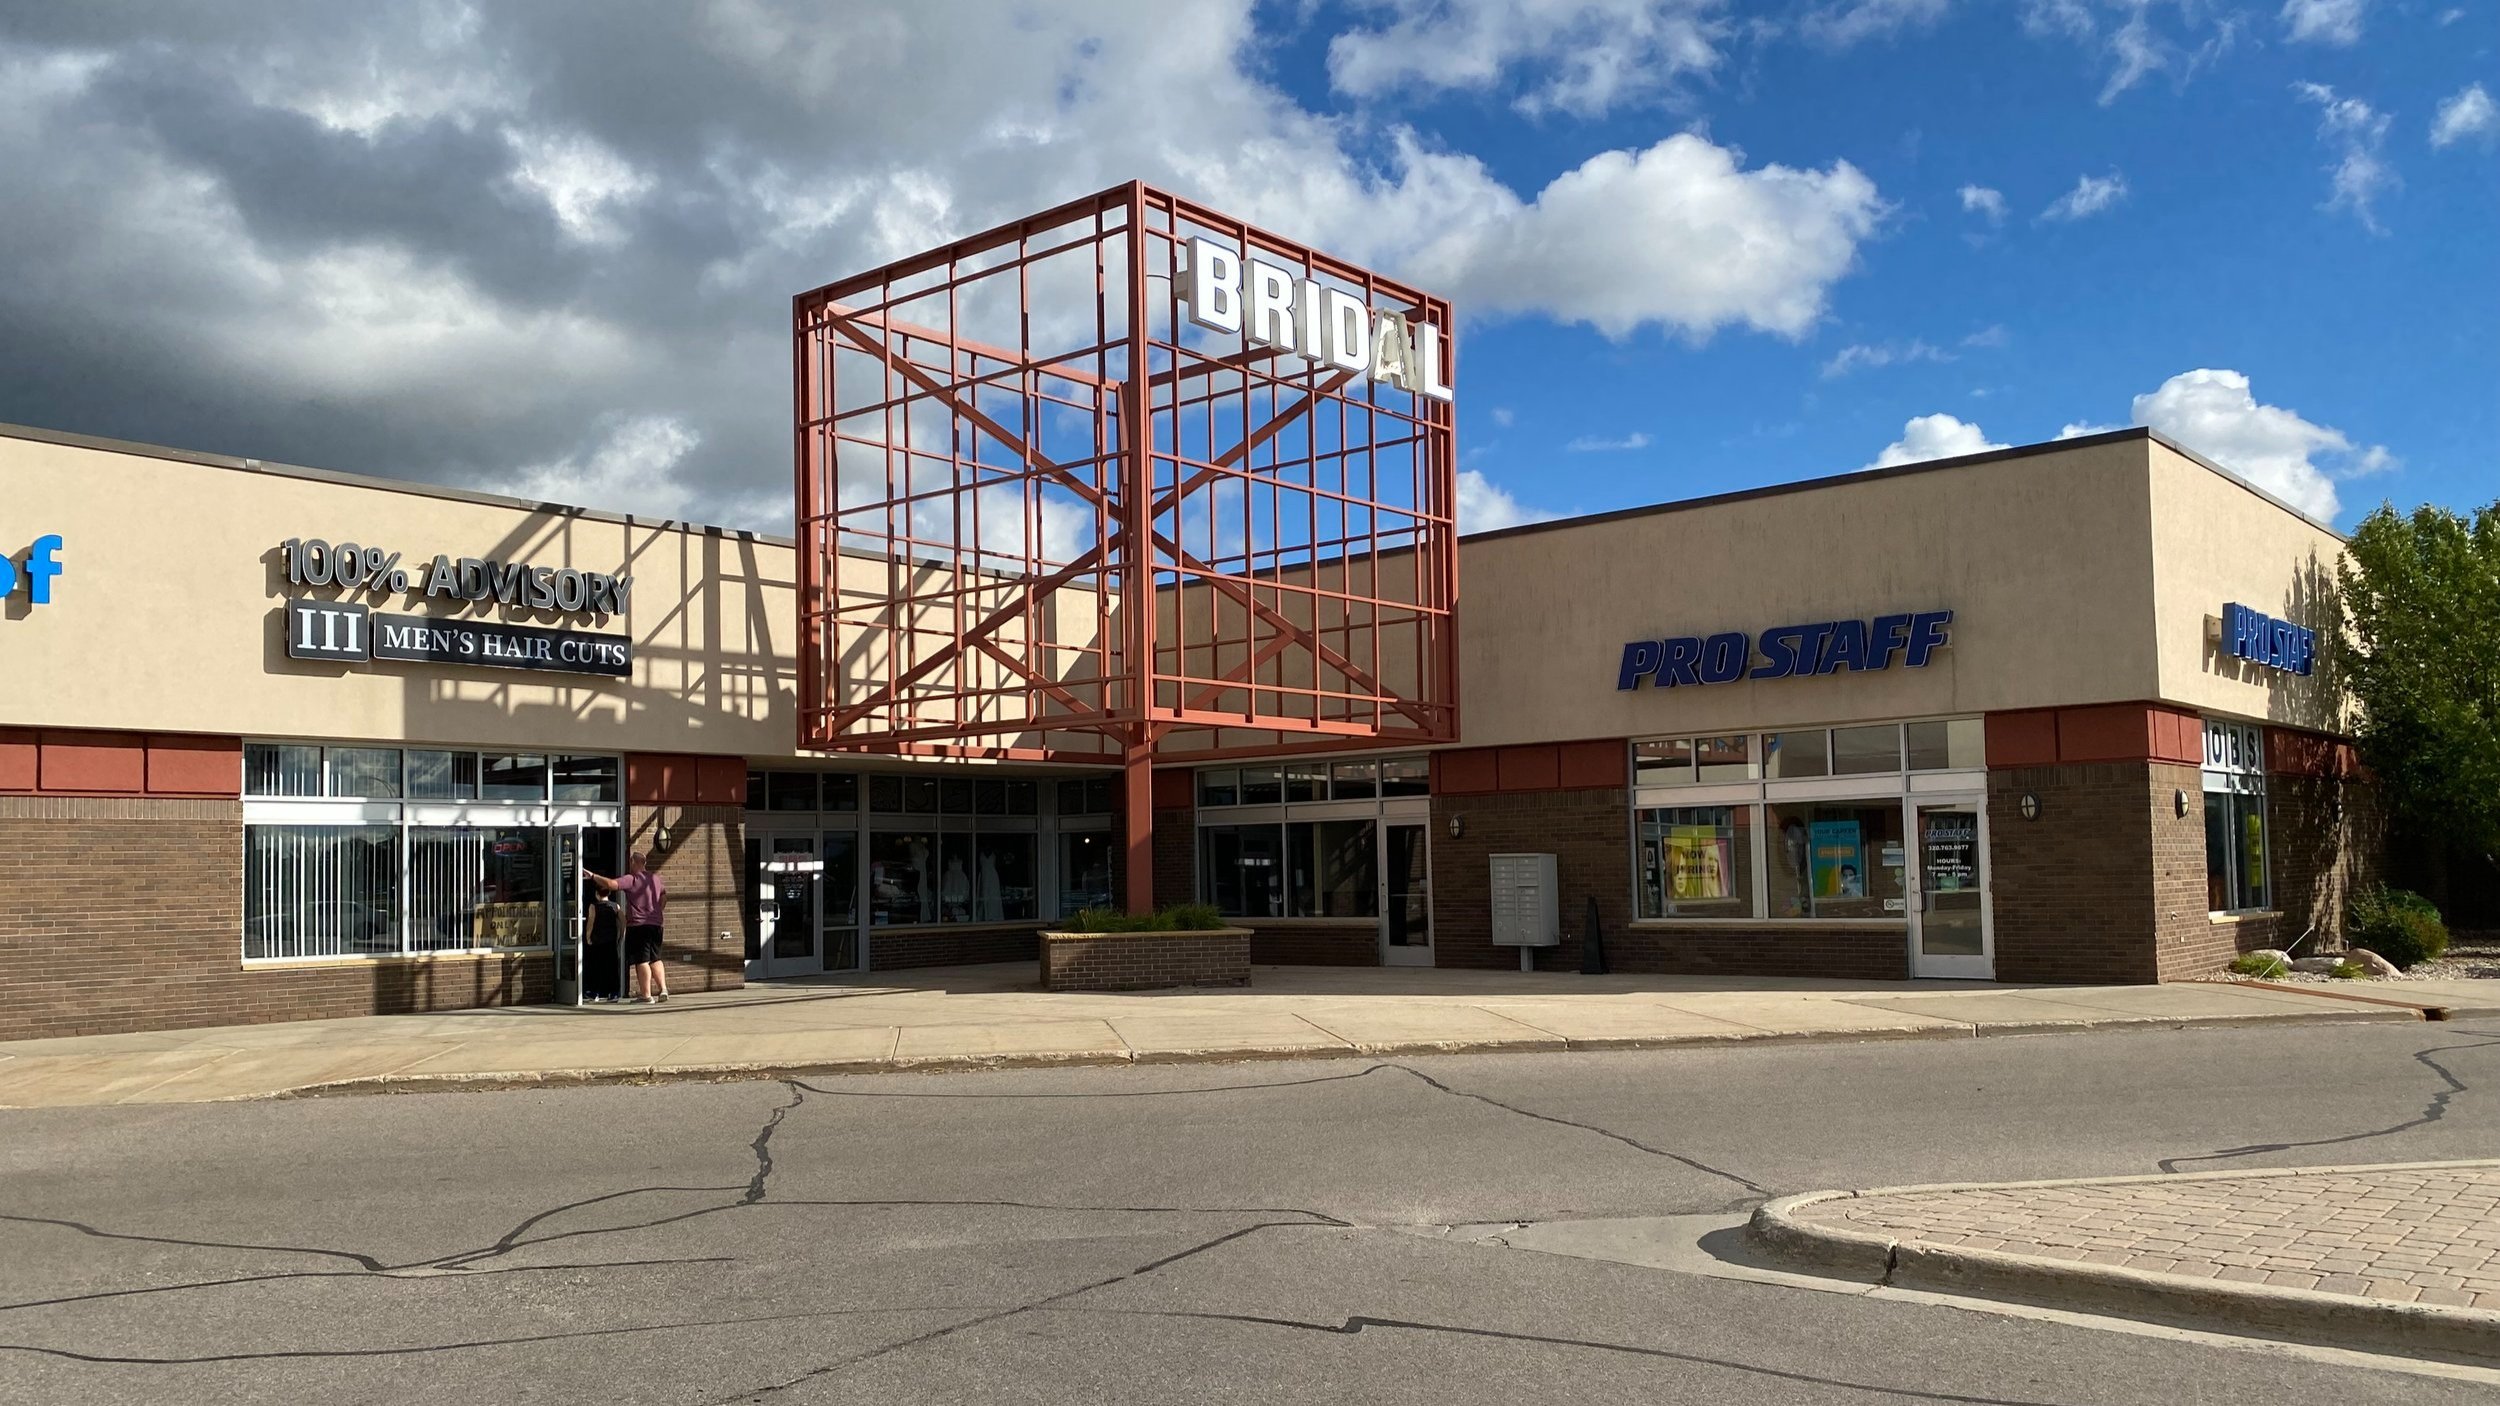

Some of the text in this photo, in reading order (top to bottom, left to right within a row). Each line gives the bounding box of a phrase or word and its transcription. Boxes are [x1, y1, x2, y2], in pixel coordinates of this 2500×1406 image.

[1187, 236, 1453, 404] BRIDAL
[282, 537, 634, 615] 100% ADVISORY
[297, 607, 362, 652] III
[384, 624, 626, 666] MEN'S HAIR CUTS
[1616, 609, 1953, 692] PRO STAFF
[2225, 602, 2272, 665] PRO
[2211, 726, 2256, 768] OBS
[1682, 850, 1707, 859] NOW
[1924, 829, 1943, 838] PRO
[476, 904, 543, 919] APPOINTMENTS
[490, 919, 517, 930] ONLY
